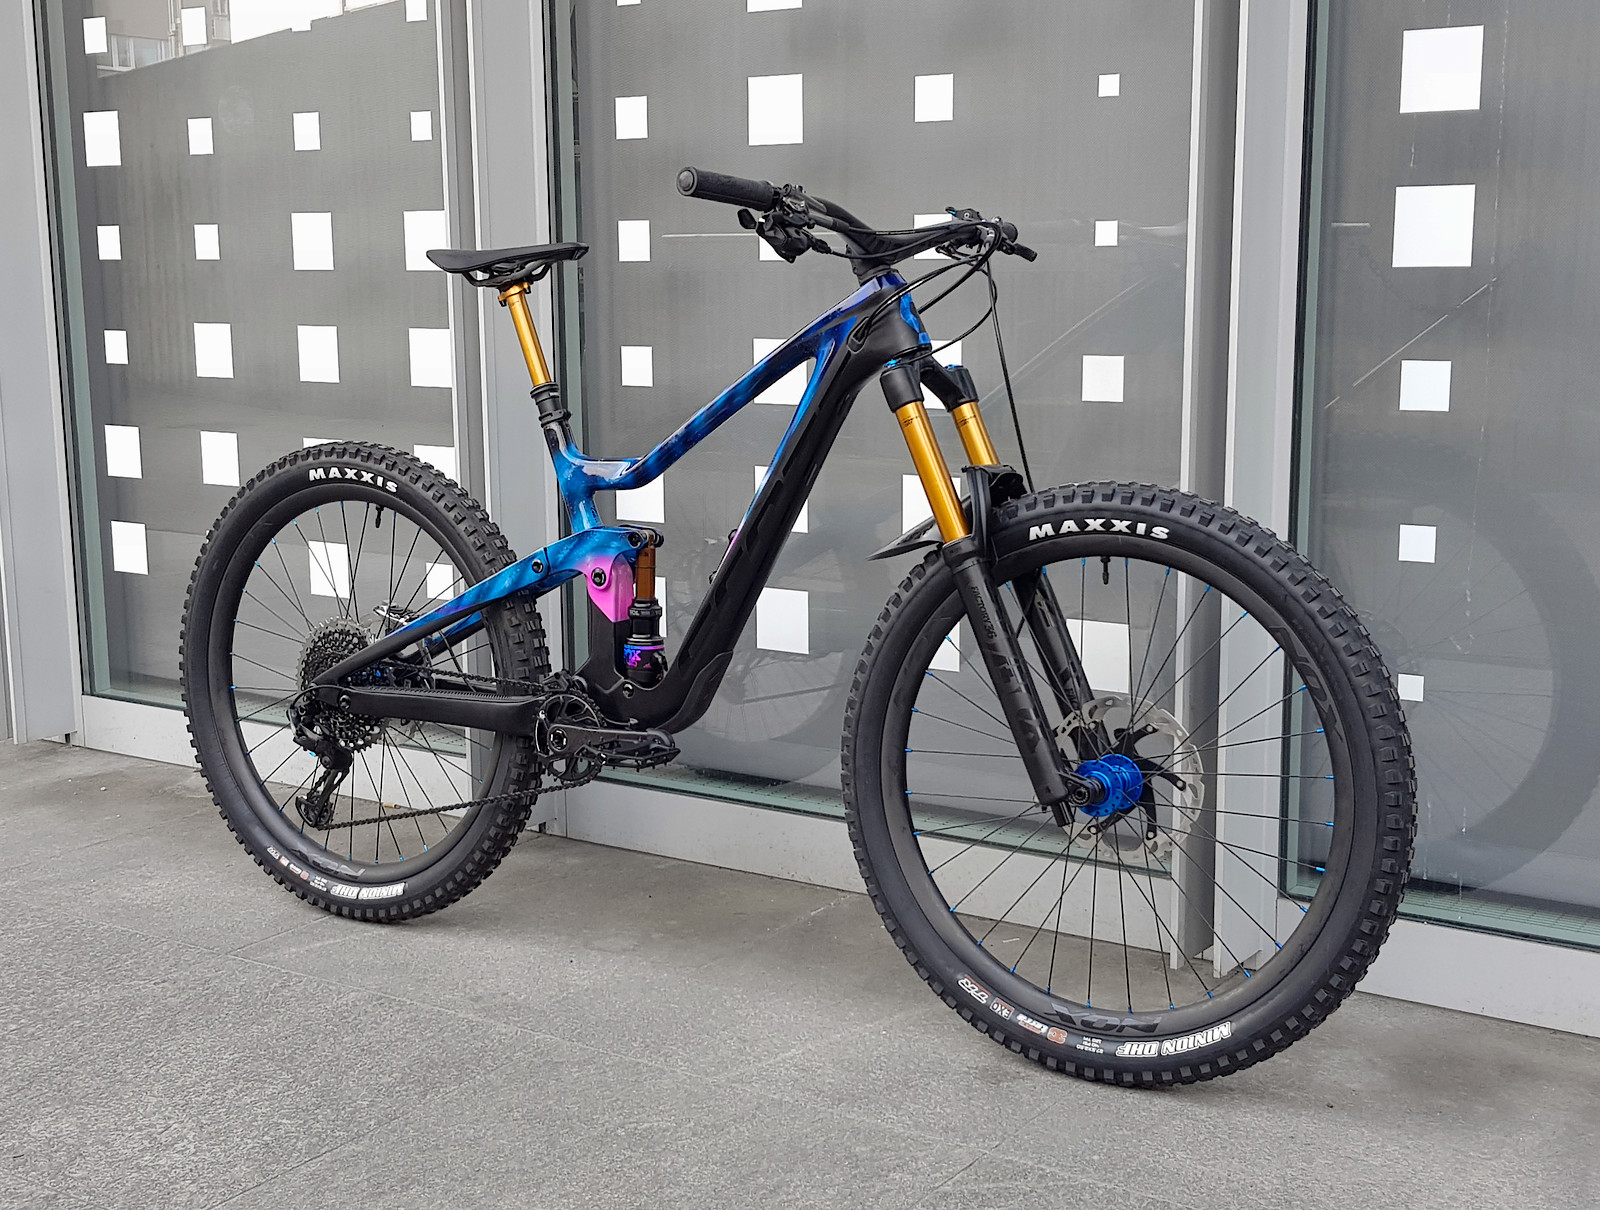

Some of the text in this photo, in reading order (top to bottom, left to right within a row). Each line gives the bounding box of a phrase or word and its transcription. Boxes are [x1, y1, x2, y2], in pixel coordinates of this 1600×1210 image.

[308, 466, 400, 495] MAXXIS
[1029, 518, 1170, 541] MAXXIS
[971, 586, 997, 639] FACTORY 36
[358, 882, 405, 900] MINION
[958, 978, 989, 1004] TR
[990, 999, 1014, 1020] EXO
[1116, 1022, 1231, 1057] MINION DHF
